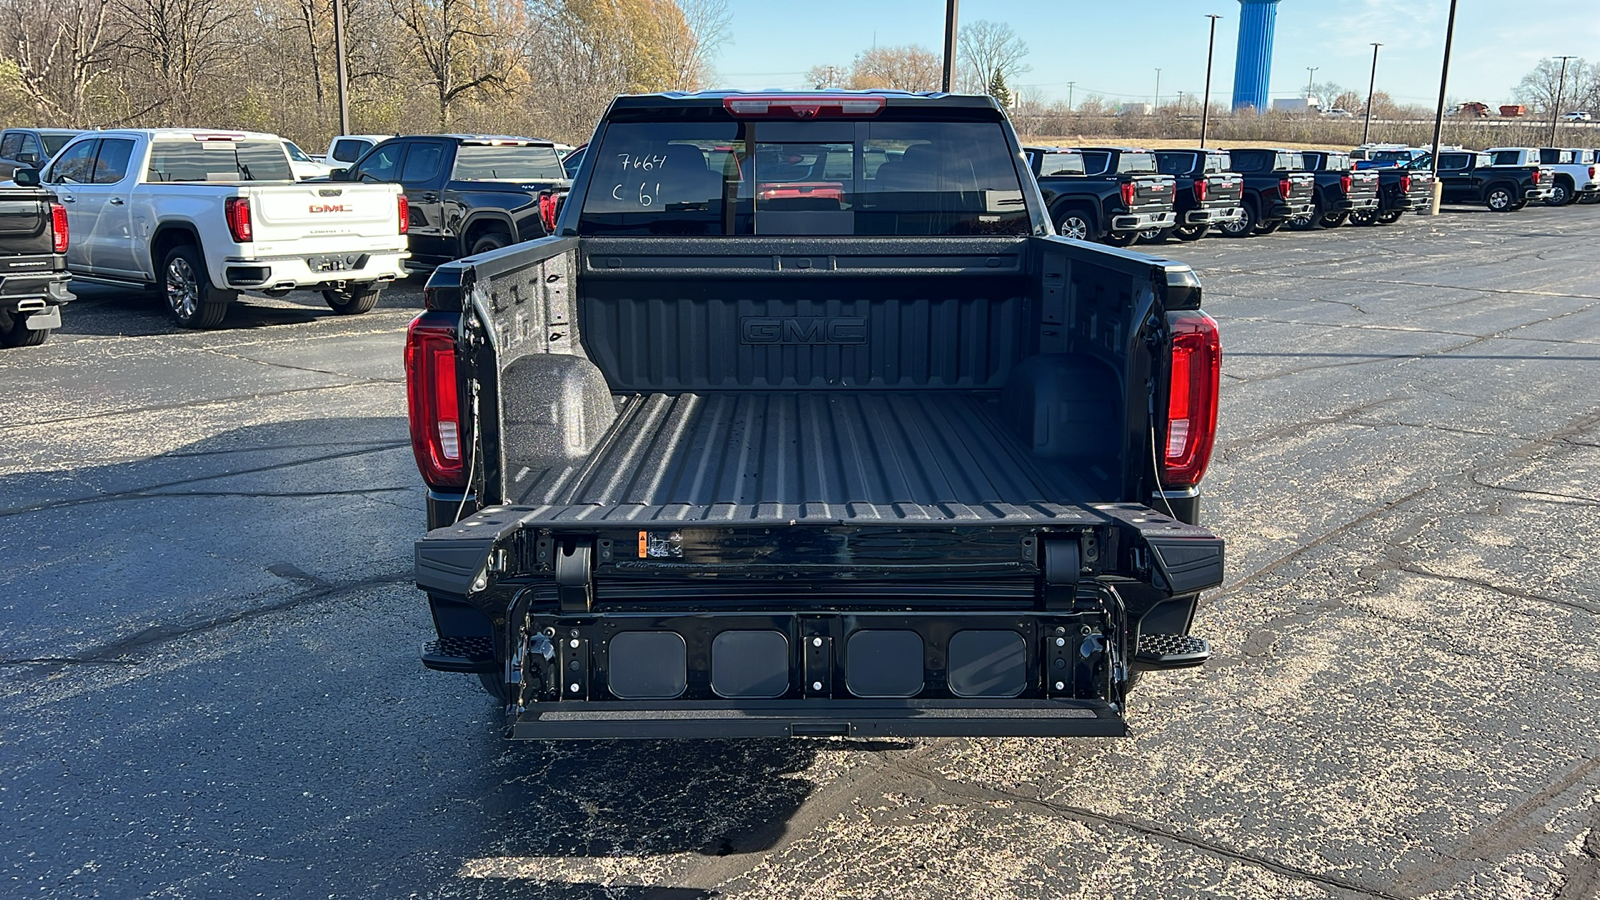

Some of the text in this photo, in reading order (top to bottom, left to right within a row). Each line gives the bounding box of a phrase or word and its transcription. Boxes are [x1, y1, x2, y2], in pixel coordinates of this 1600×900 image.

[617, 153, 667, 171] 7664
[612, 182, 661, 207] C 61
[742, 318, 866, 343] GMC
